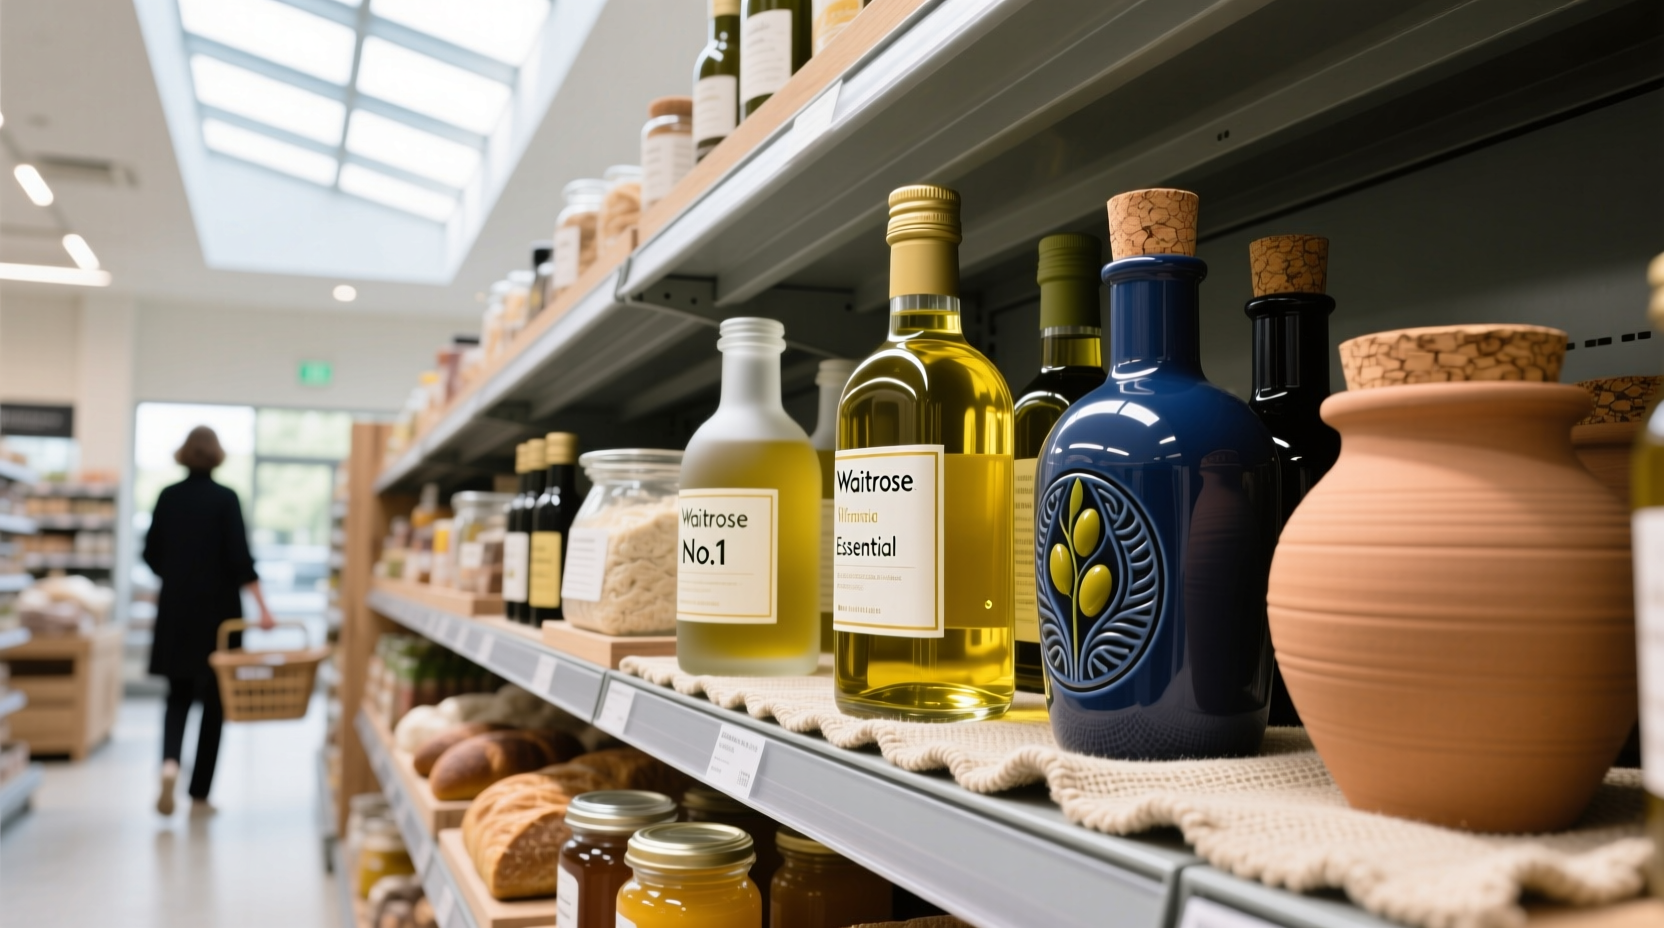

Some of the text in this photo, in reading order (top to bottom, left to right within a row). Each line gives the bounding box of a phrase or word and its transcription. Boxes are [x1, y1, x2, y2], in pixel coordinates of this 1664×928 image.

[836, 469, 914, 494] Waitrose
[681, 507, 748, 529] Waitrose
[682, 538, 726, 566] No.1
[836, 535, 896, 557] Essential
